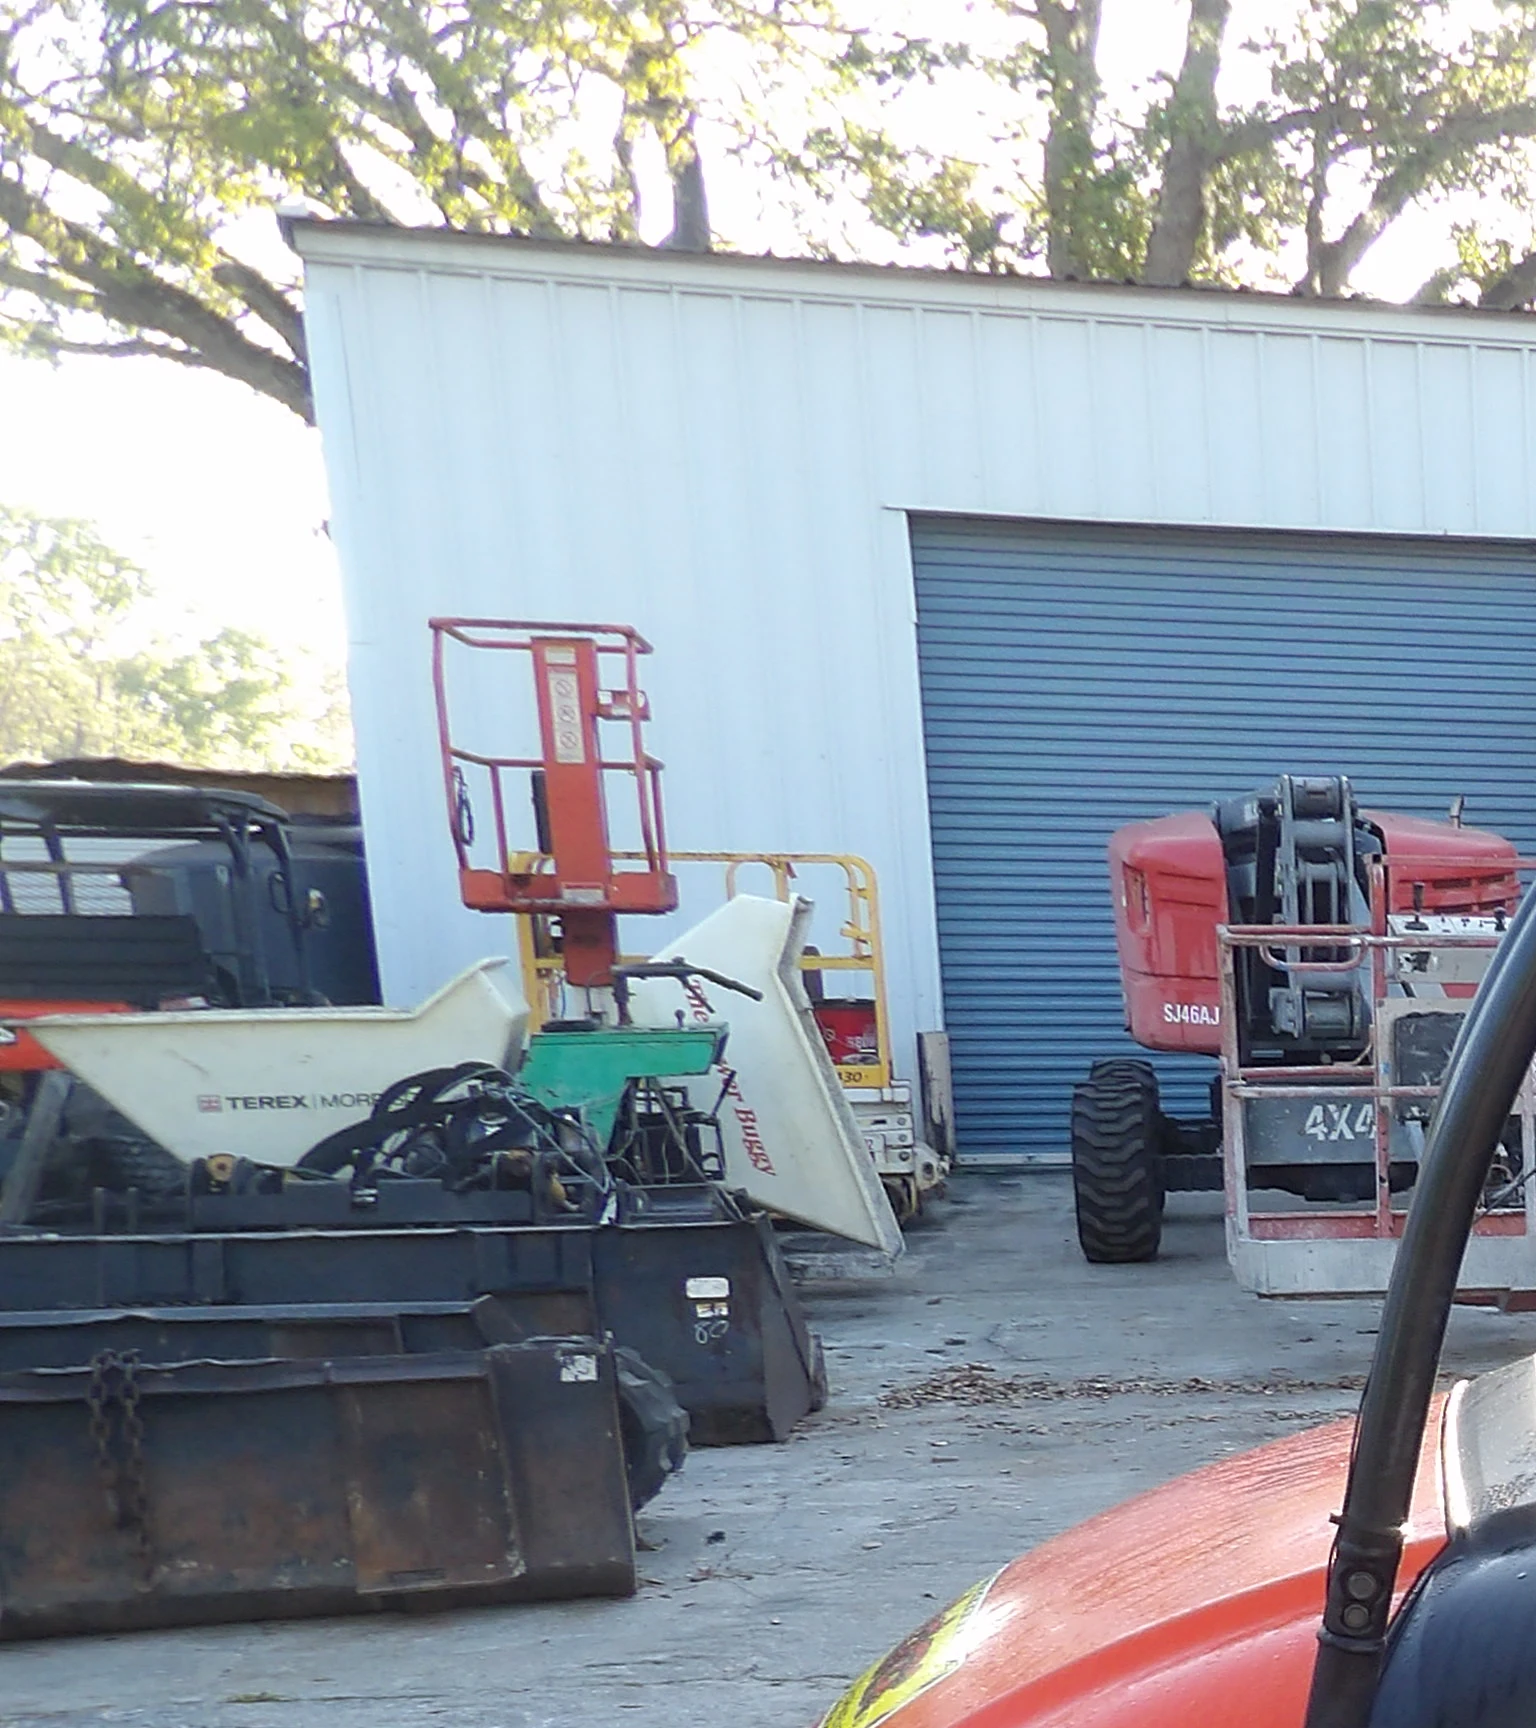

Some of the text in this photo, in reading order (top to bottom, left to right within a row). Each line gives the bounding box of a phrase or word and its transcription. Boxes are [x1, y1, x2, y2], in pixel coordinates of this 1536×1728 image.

[1163, 1003, 1220, 1025] SJ46AJ
[226, 1095, 308, 1110] TEREX
[1305, 1103, 1376, 1141] 4X4
[734, 1105, 777, 1176] Buggy
